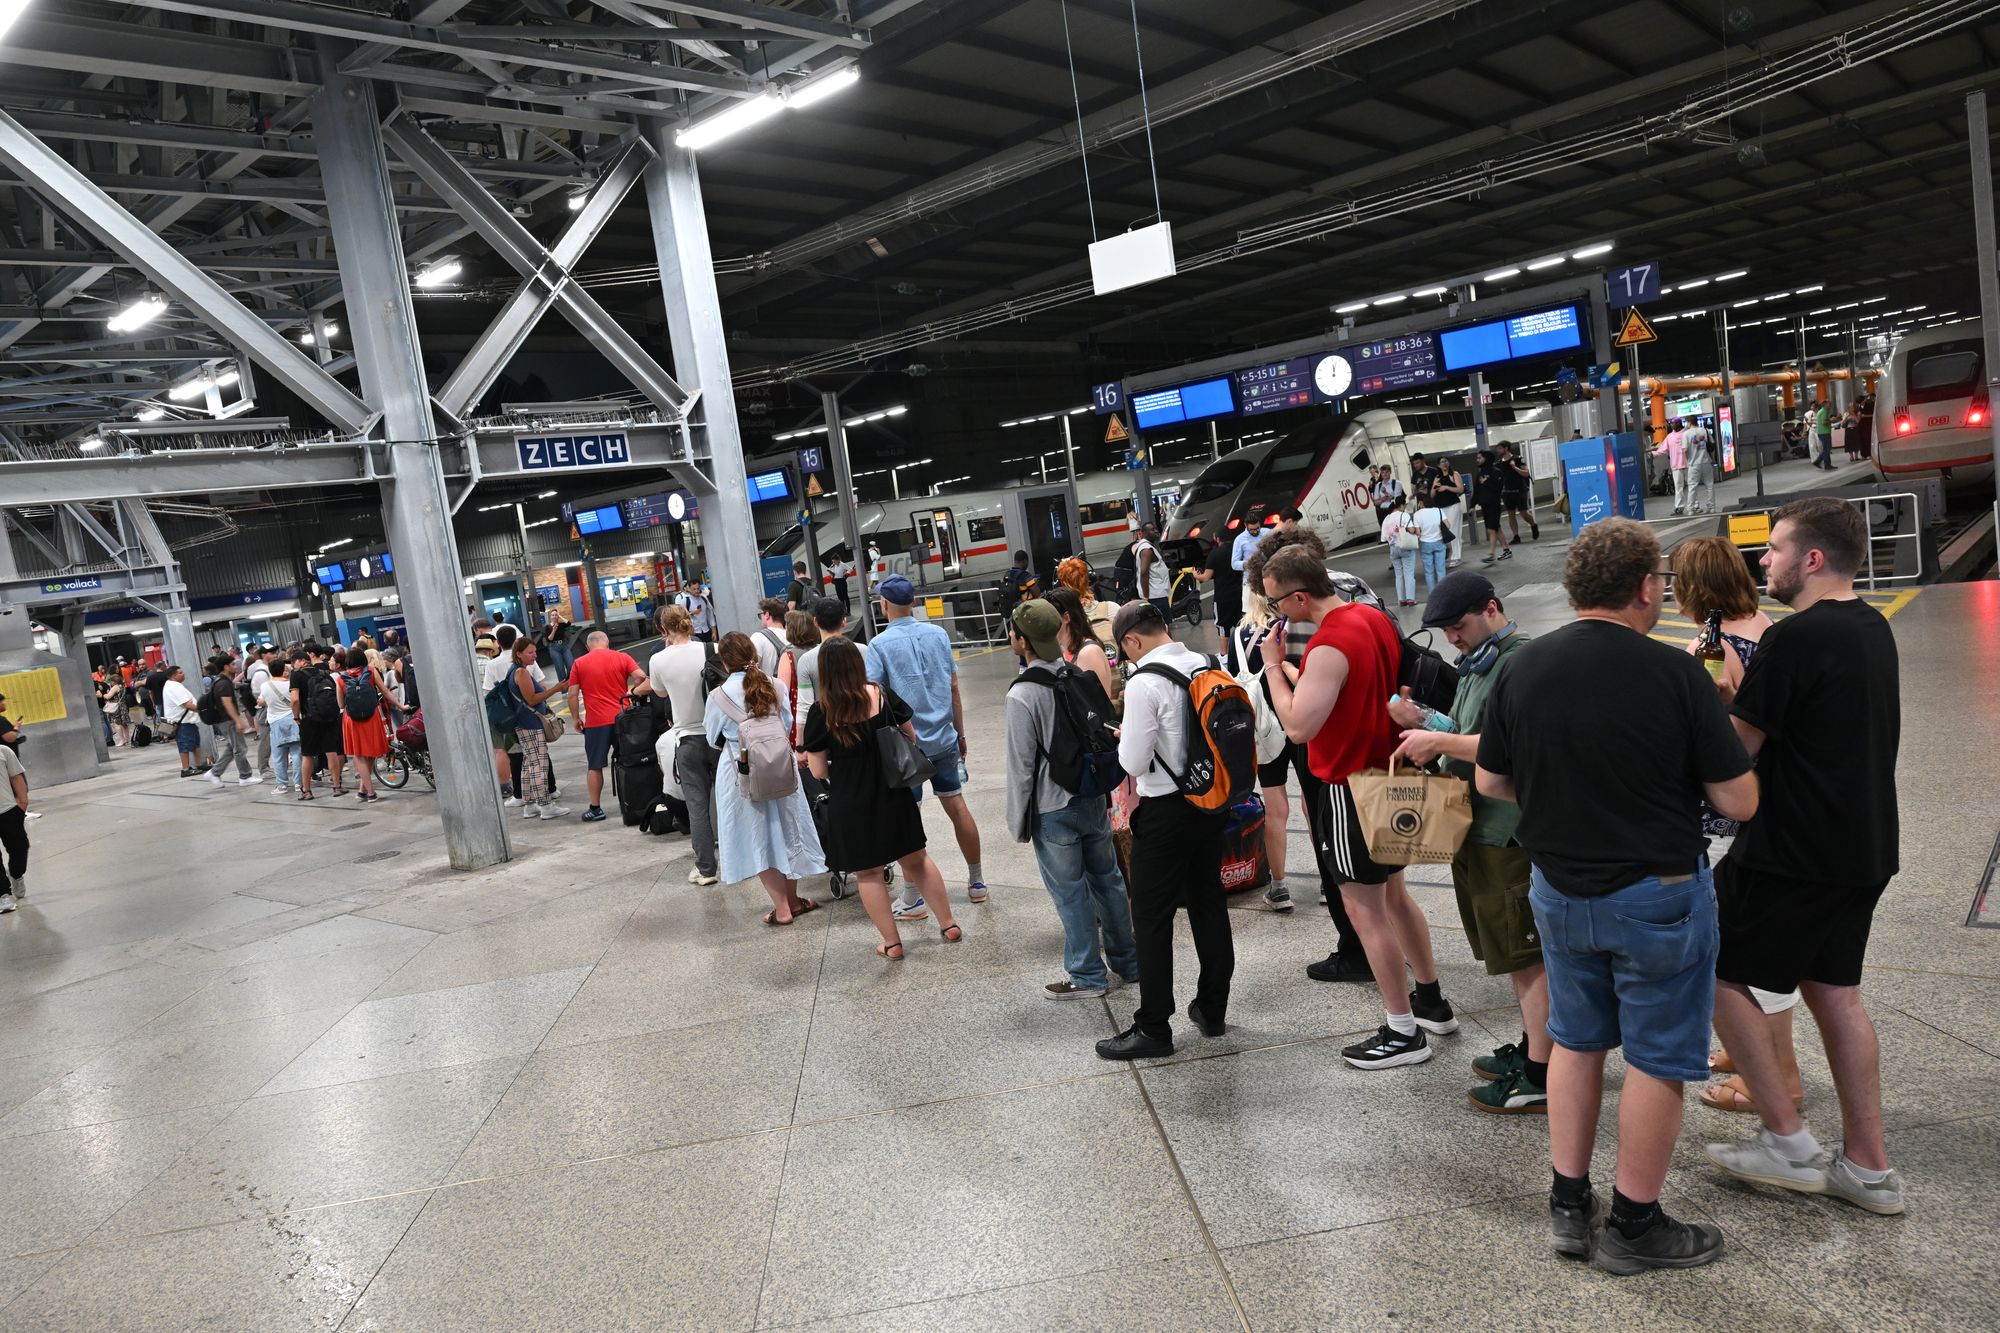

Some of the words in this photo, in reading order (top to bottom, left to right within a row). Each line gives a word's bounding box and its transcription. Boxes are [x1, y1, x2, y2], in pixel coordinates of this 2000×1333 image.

[1619, 265, 1651, 297] 17
[1373, 345, 1381, 355] U
[1394, 337, 1423, 352] 18-36
[1248, 369, 1268, 381] 5-15
[1269, 367, 1276, 377] U
[1095, 384, 1117, 407] 16
[1929, 416, 1949, 426] DB
[526, 438, 624, 464] ZECH
[803, 449, 818, 467] 15
[1338, 480, 1350, 488] TGV
[562, 503, 573, 518] 14
[888, 556, 915, 576] ICE
[64, 577, 98, 589] vollack
[130, 606, 145, 614] 5-10
[1386, 786, 1426, 794] POMMES
